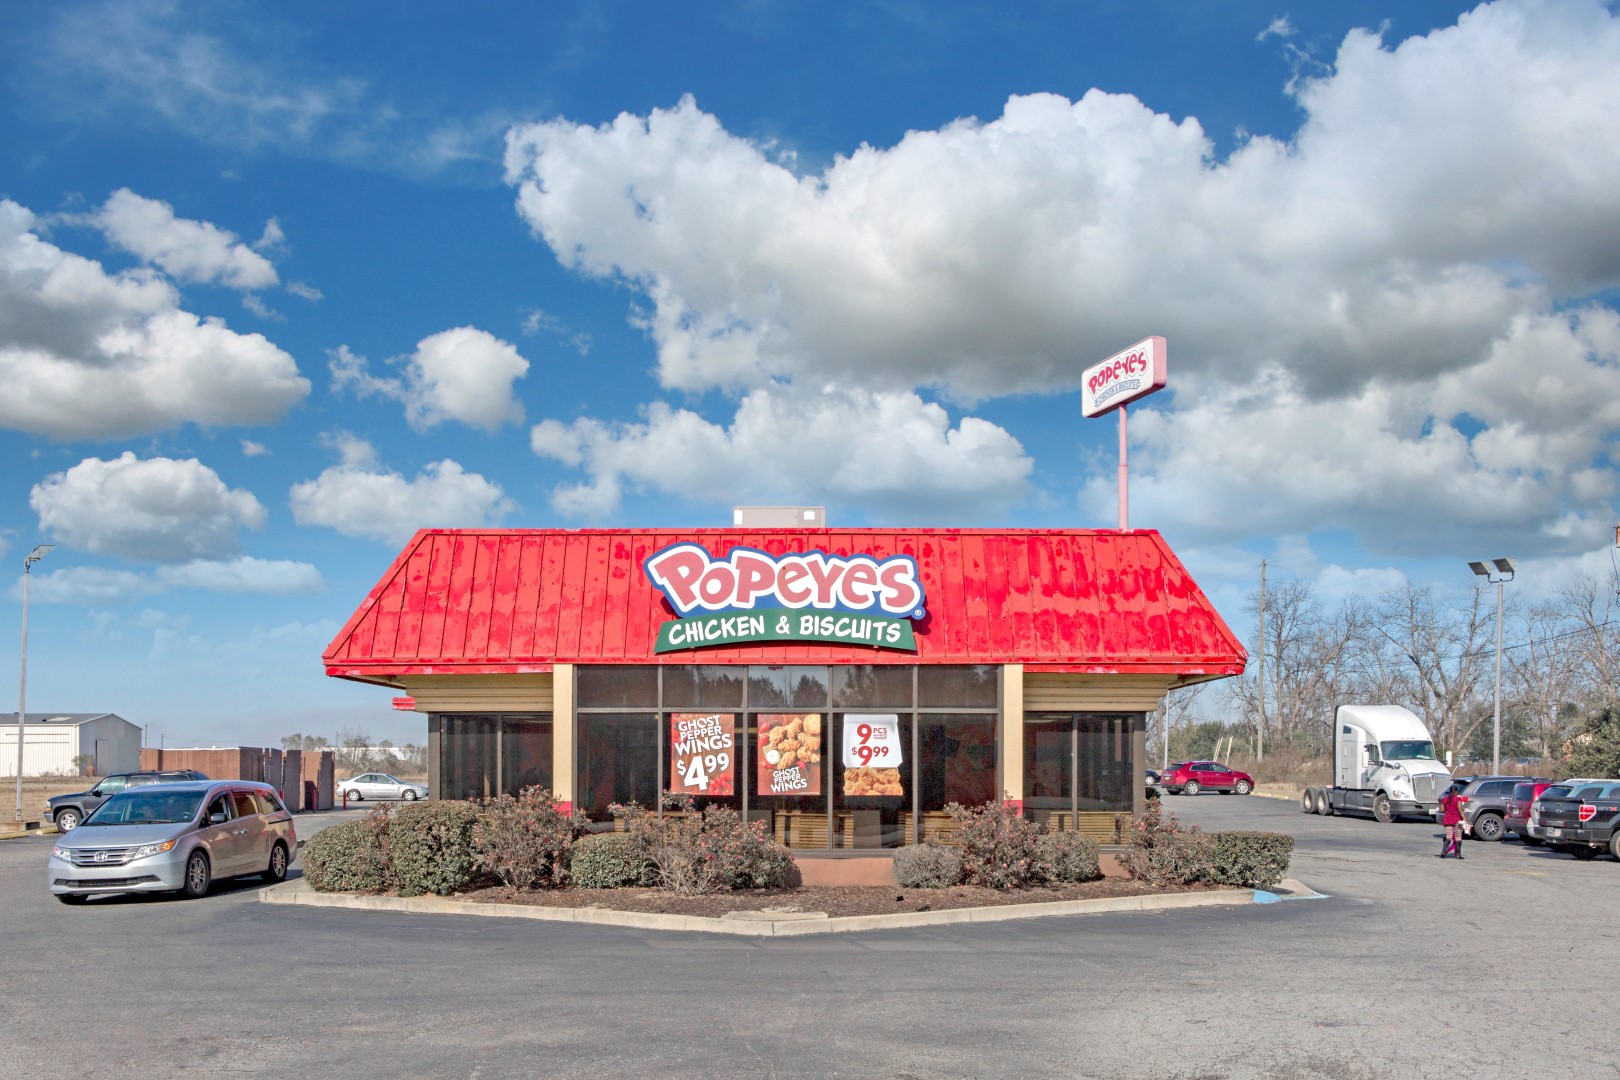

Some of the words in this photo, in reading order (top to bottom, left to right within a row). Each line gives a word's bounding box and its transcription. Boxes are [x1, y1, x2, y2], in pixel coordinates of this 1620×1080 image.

[668, 615, 765, 645] CHICKEN
[775, 615, 790, 635] &
[799, 616, 901, 643] BISCUITS
[678, 714, 721, 732] GHOST
[680, 725, 722, 741] PEPPER
[856, 723, 872, 745] 9
[674, 733, 732, 757] WINGS
[772, 766, 800, 778] GHOST
[773, 773, 801, 784] PEPPER
[770, 778, 808, 794] WINGS
